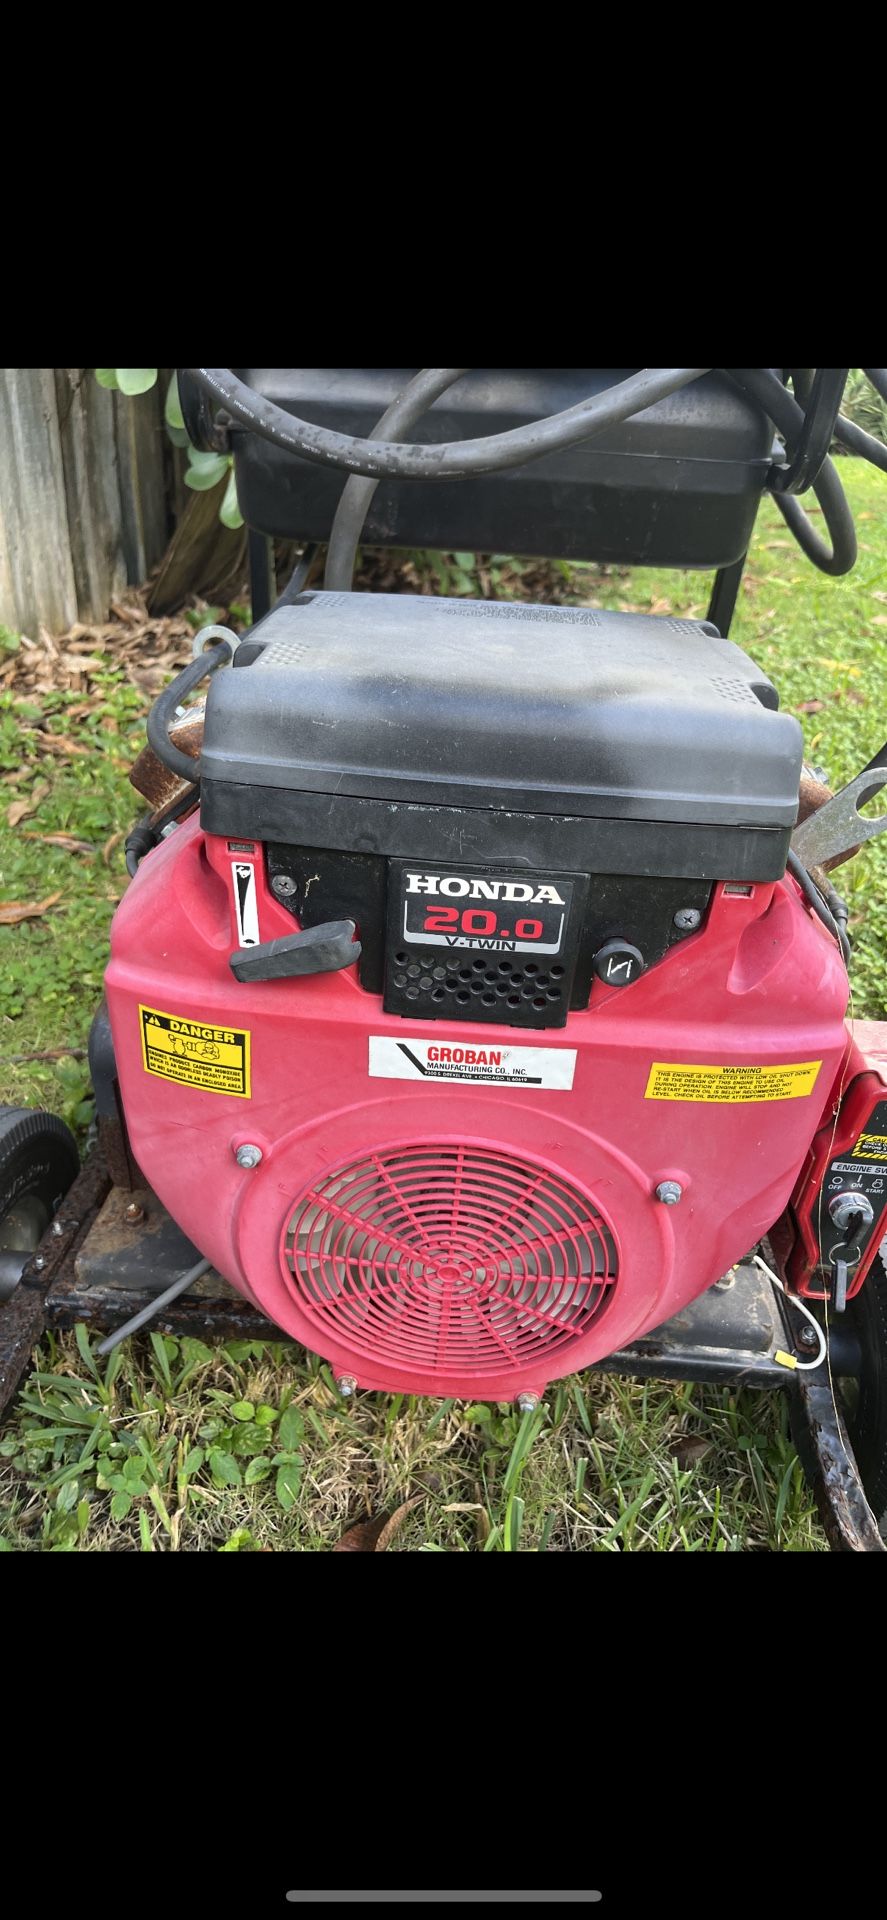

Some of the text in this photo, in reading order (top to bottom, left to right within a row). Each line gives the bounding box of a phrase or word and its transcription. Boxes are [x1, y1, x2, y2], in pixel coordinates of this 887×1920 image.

[406, 874, 565, 905] HONDA
[423, 905, 544, 939] 20.0
[445, 936, 516, 951] V-TWIN
[170, 1021, 235, 1043] DANGER
[427, 1046, 502, 1066] GROBAN
[150, 1056, 163, 1064] WHICH
[178, 1064, 202, 1075] ODORLESS
[203, 1071, 221, 1080] DEADLY
[169, 1056, 190, 1066] PRODUCE
[193, 1063, 212, 1072] CARBON
[215, 1068, 241, 1077] MONOXIDE
[427, 1062, 528, 1076] MANUFACTURING CO., INC.
[167, 1067, 186, 1078] OPERATE
[202, 1077, 226, 1087] ENCLOSED
[837, 1163, 872, 1173] ENGINE
